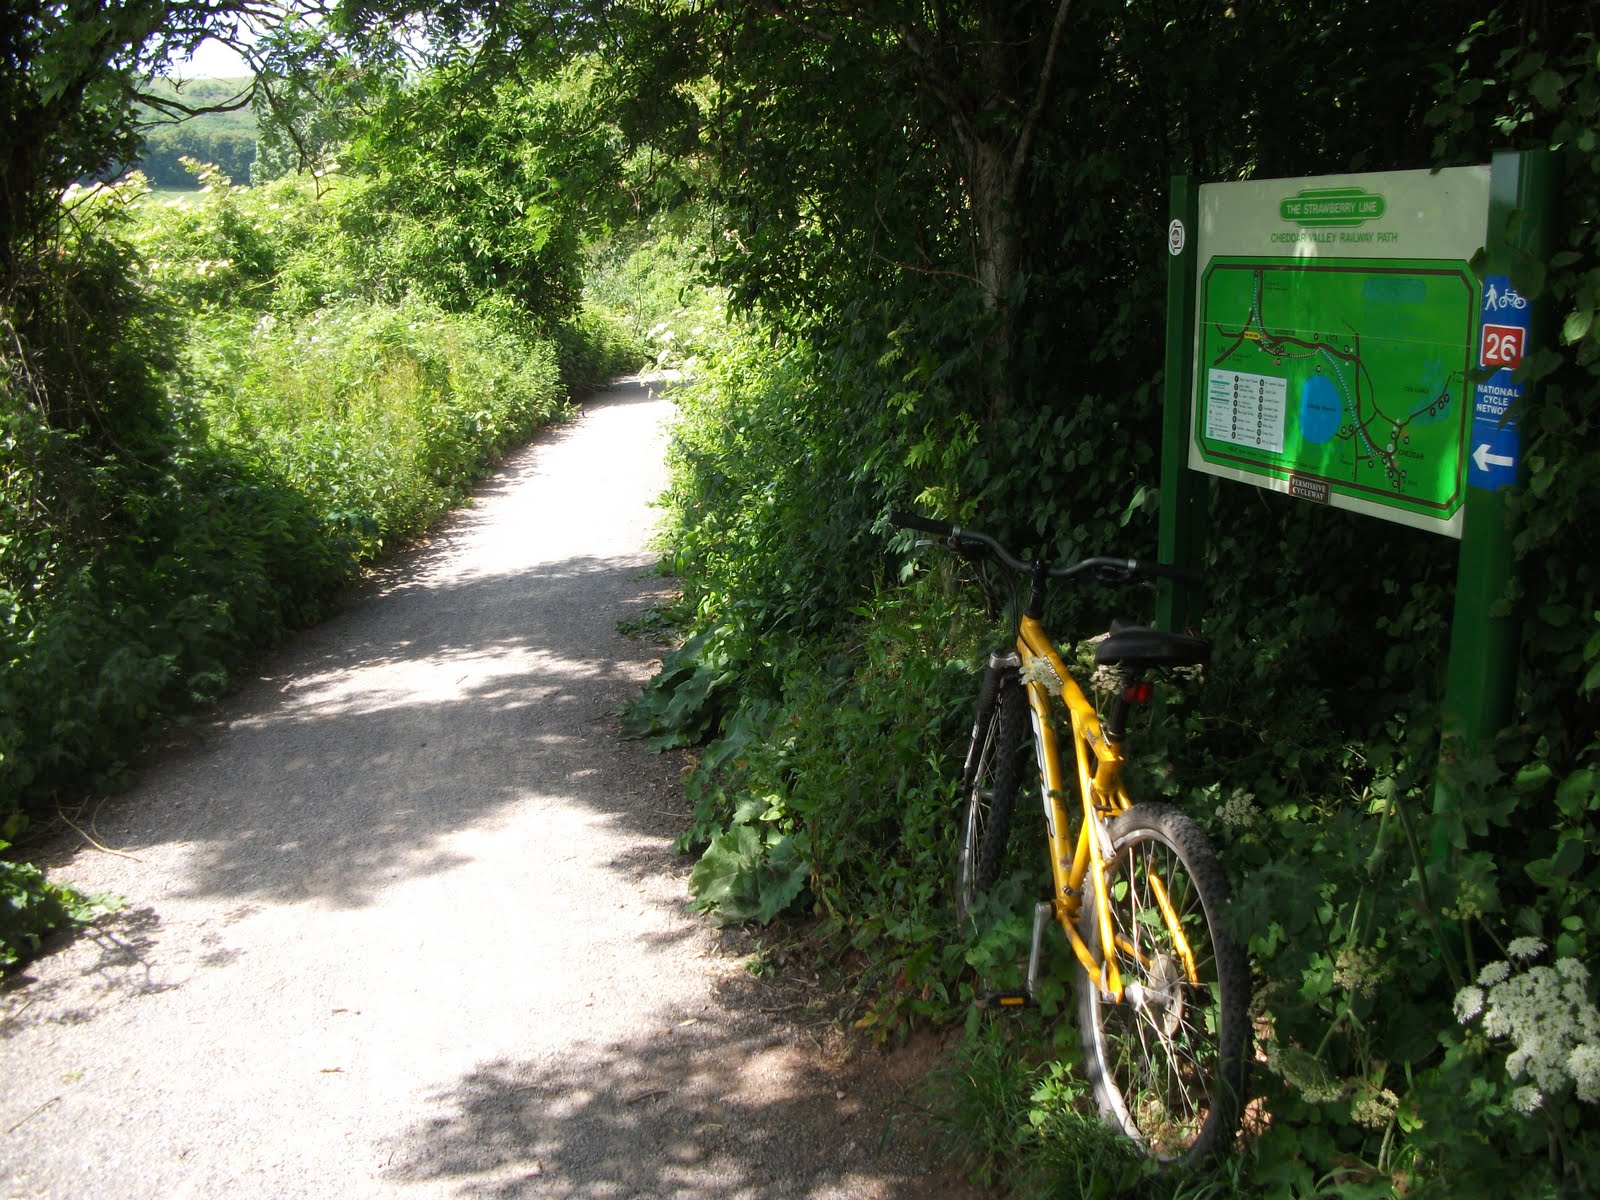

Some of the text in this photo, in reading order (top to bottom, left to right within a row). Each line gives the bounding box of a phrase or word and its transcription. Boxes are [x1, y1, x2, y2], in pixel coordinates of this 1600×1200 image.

[1287, 201, 1377, 215] THE STRAWBERRY LINE
[1271, 232, 1305, 243] CHEDDAR
[1340, 232, 1374, 243] RAILWAY
[1377, 232, 1399, 243] PATH
[1486, 333, 1516, 361] 26
[1478, 384, 1519, 397] NATIONAL
[1483, 394, 1508, 406] CYCLE
[1477, 403, 1509, 415] NETWO
[1292, 478, 1326, 493] PERMISSIVE
[1292, 487, 1325, 500] CYCLEWAY
